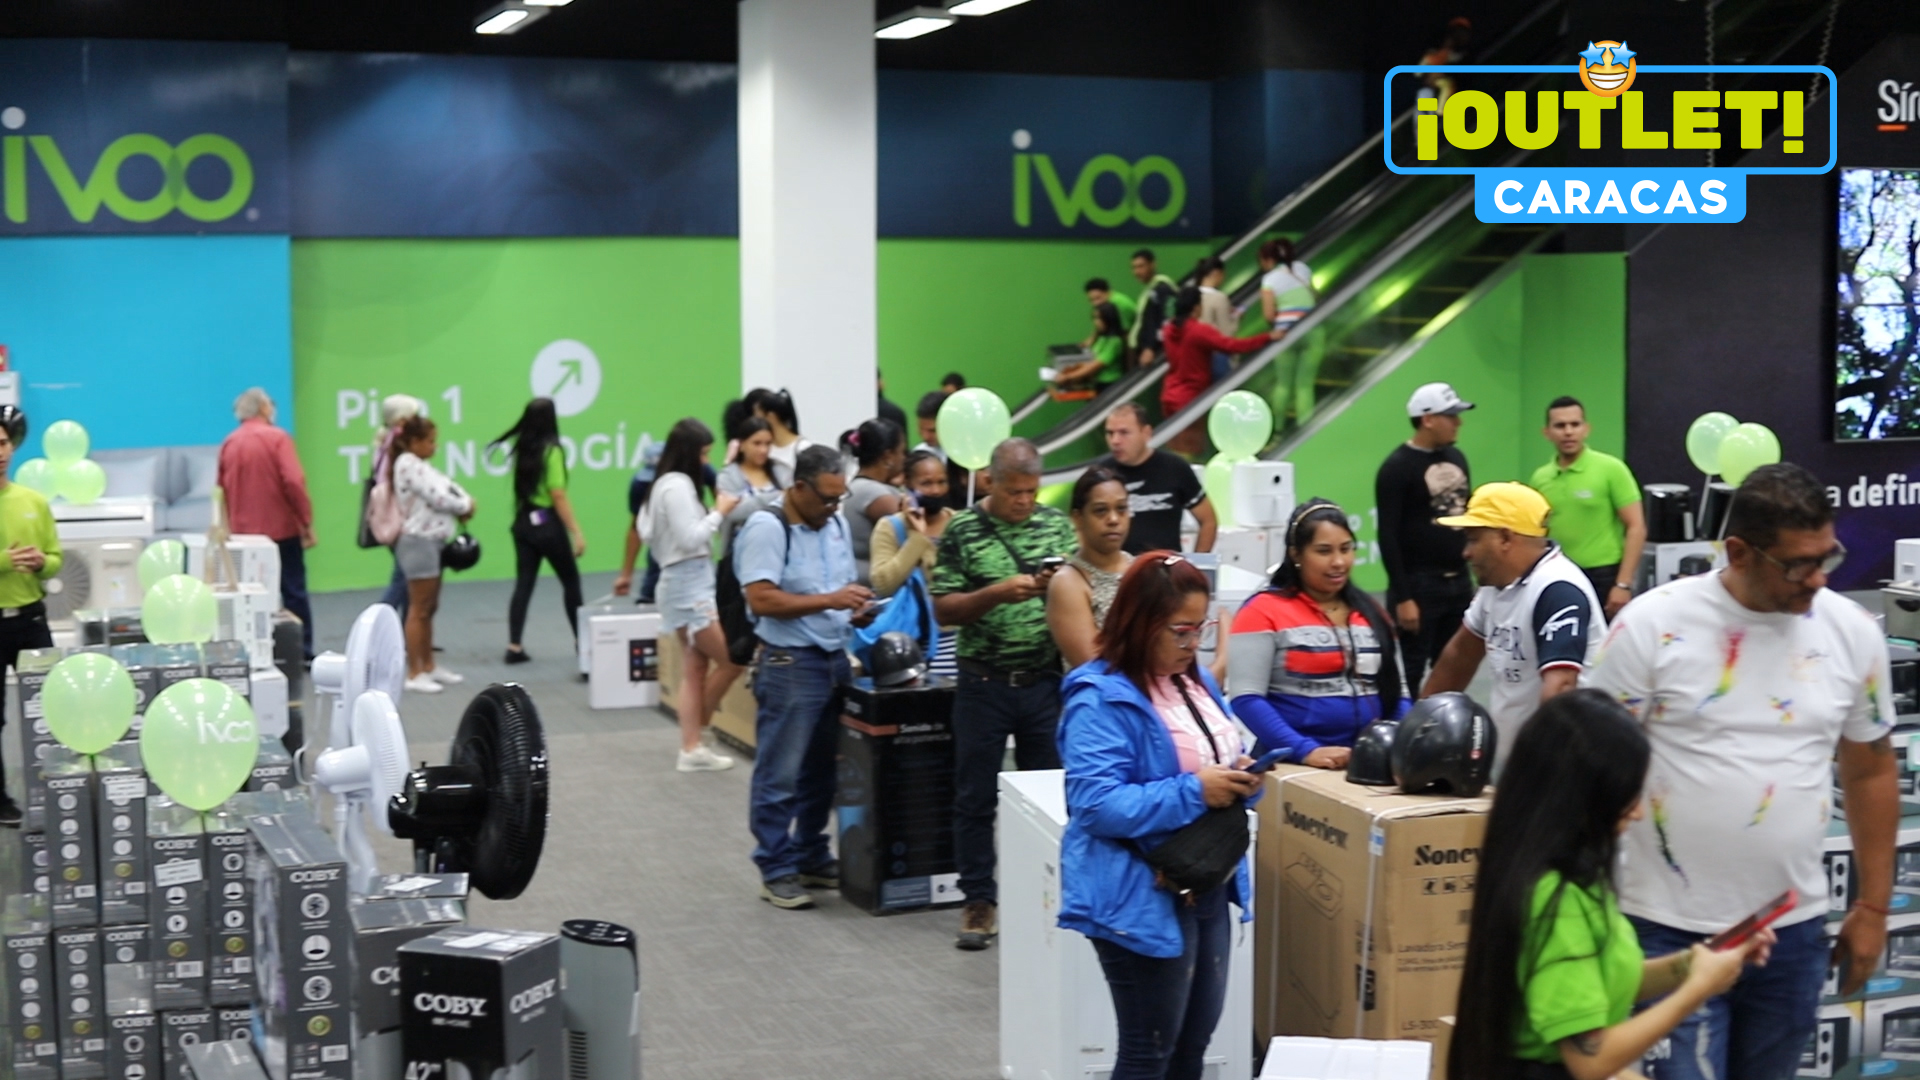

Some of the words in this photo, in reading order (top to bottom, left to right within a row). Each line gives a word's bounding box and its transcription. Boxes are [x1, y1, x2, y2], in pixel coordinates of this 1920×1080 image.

[1877, 79, 1920, 122] Sír
[2, 105, 254, 223] ivoo
[1012, 128, 1186, 227] ivoo
[442, 385, 462, 424] 1
[252, 766, 290, 778] COBY
[48, 777, 87, 790] COBY
[154, 838, 199, 851] COBY
[289, 868, 341, 884] COBY
[7, 936, 46, 948] COBY
[58, 932, 97, 944] COBY
[106, 930, 145, 942] COBY
[509, 978, 557, 1014] COBY
[413, 992, 489, 1018] COBY
[112, 1016, 155, 1029] COBY
[168, 1013, 211, 1026] COBY
